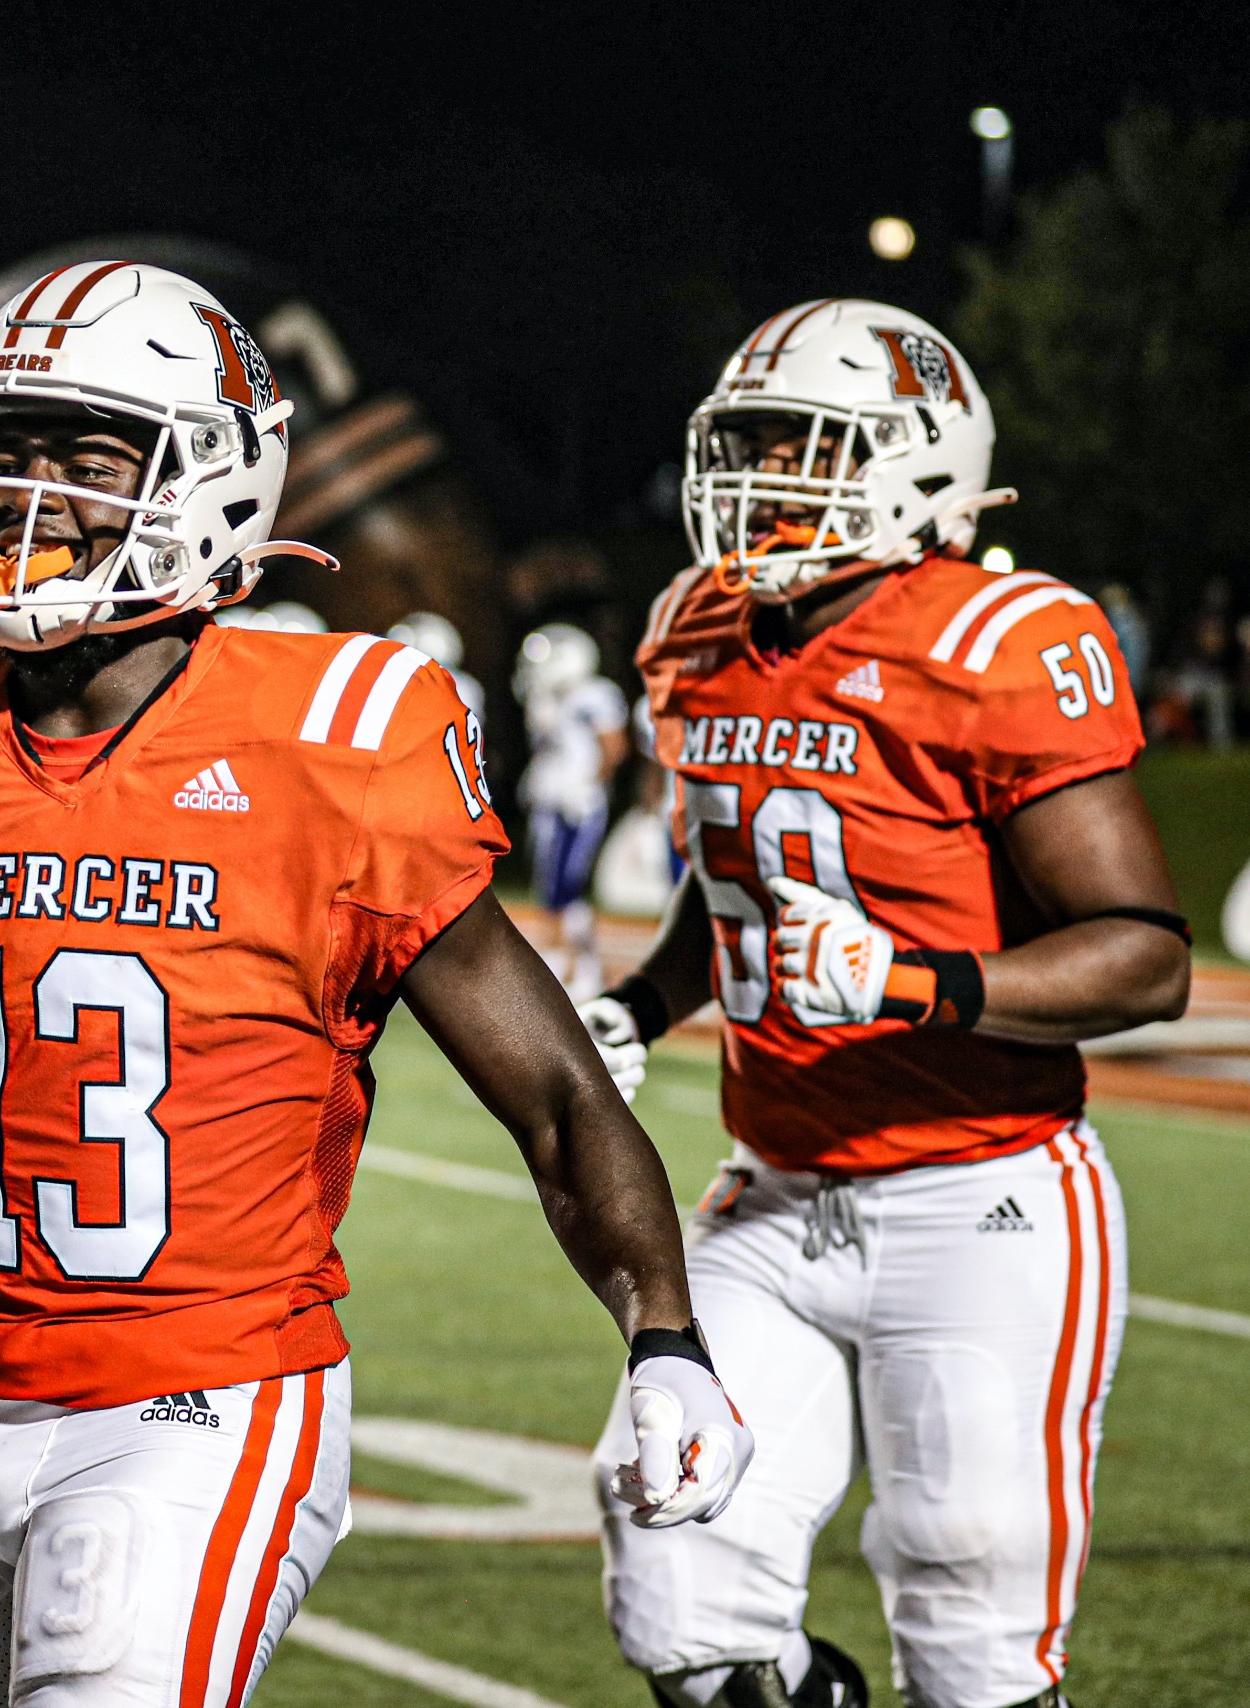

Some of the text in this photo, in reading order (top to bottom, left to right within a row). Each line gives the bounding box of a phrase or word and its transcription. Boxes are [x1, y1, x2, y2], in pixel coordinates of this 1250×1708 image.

[1038, 631, 1115, 720] 50
[442, 708, 493, 823] 13
[678, 716, 859, 776] MERCER
[174, 788, 250, 812] adidas
[140, 1404, 220, 1428] adidas
